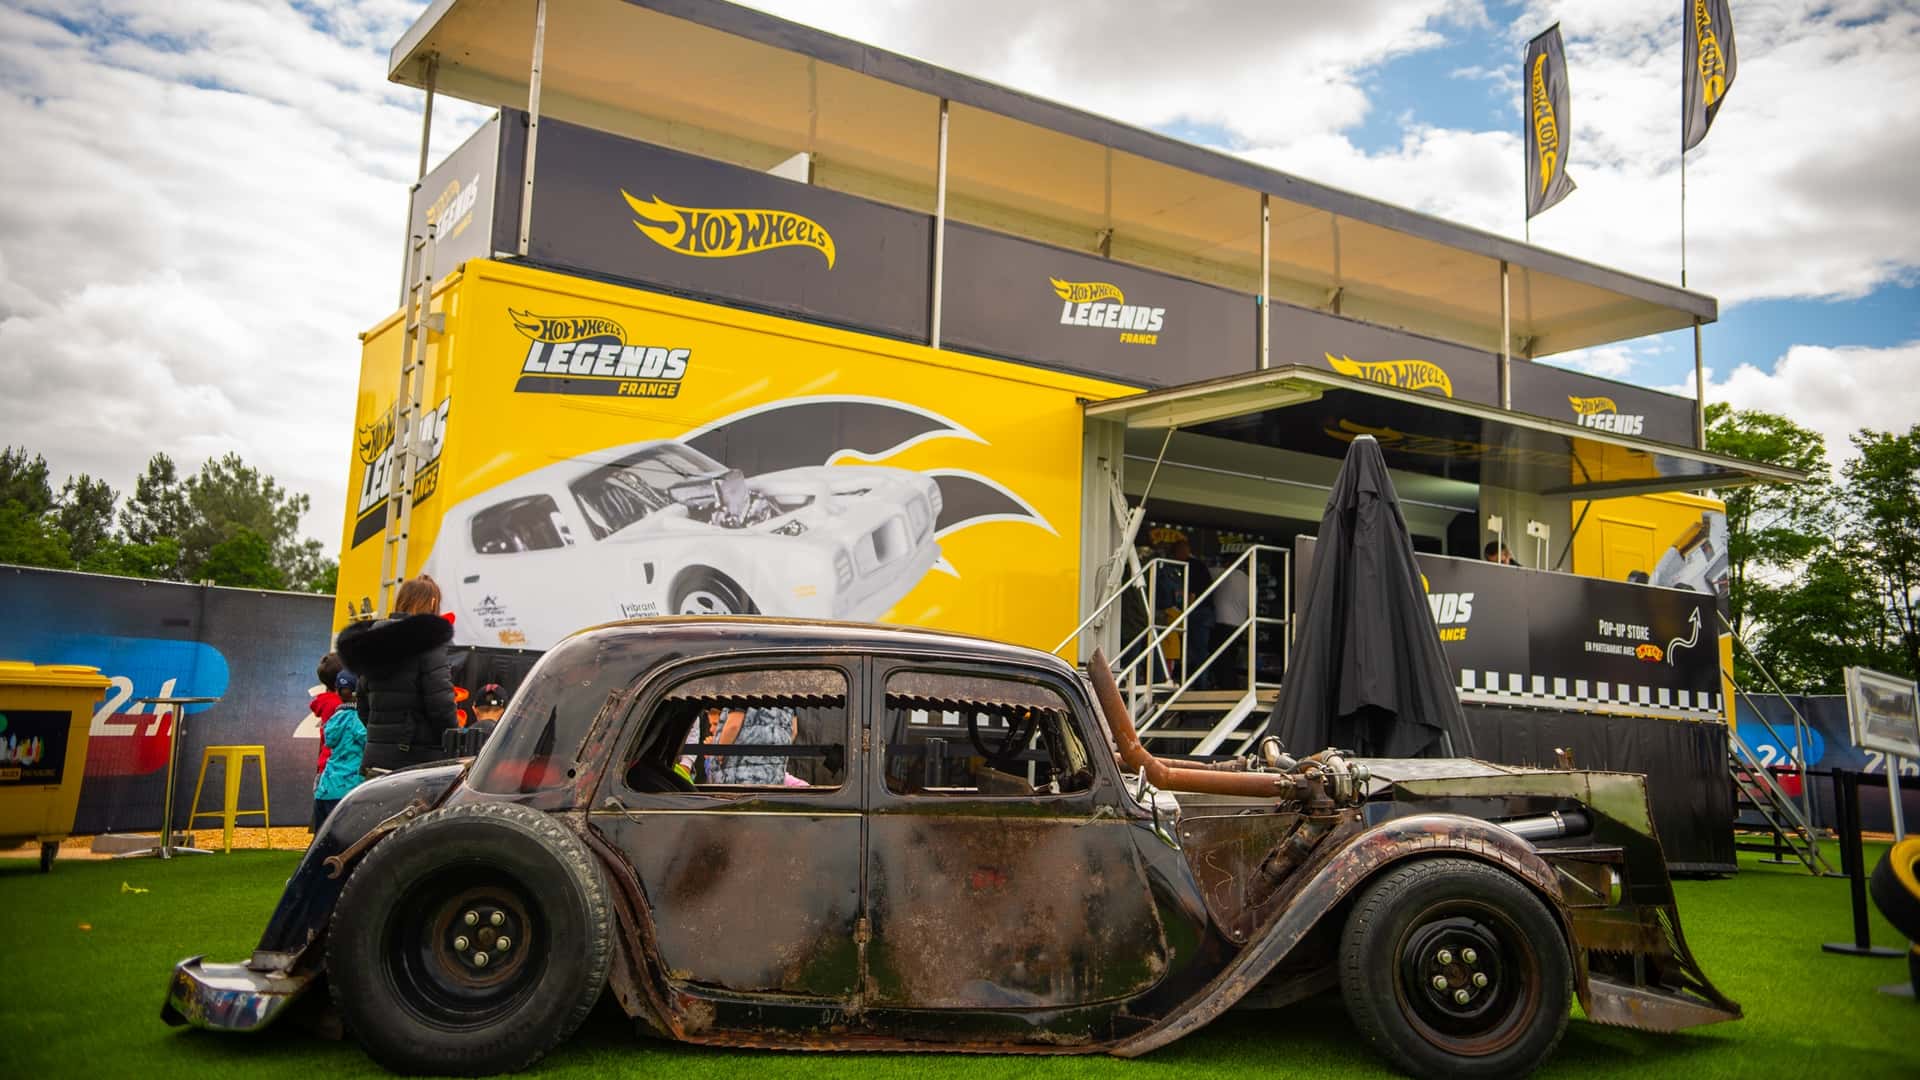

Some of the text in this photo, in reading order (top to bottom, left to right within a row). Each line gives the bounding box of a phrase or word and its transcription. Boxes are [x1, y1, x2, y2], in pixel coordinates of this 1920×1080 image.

[1060, 301, 1165, 331] LEGENDS
[1120, 332, 1158, 345] FRANCE
[523, 340, 692, 379] LEGENDS
[617, 382, 676, 396] FRANCE
[1577, 413, 1645, 435] LEGENDS
[1439, 627, 1467, 641] ANCE
[1627, 624, 1649, 640] STORE
[1585, 641, 1592, 651] EN
[1623, 646, 1635, 656] AVEC
